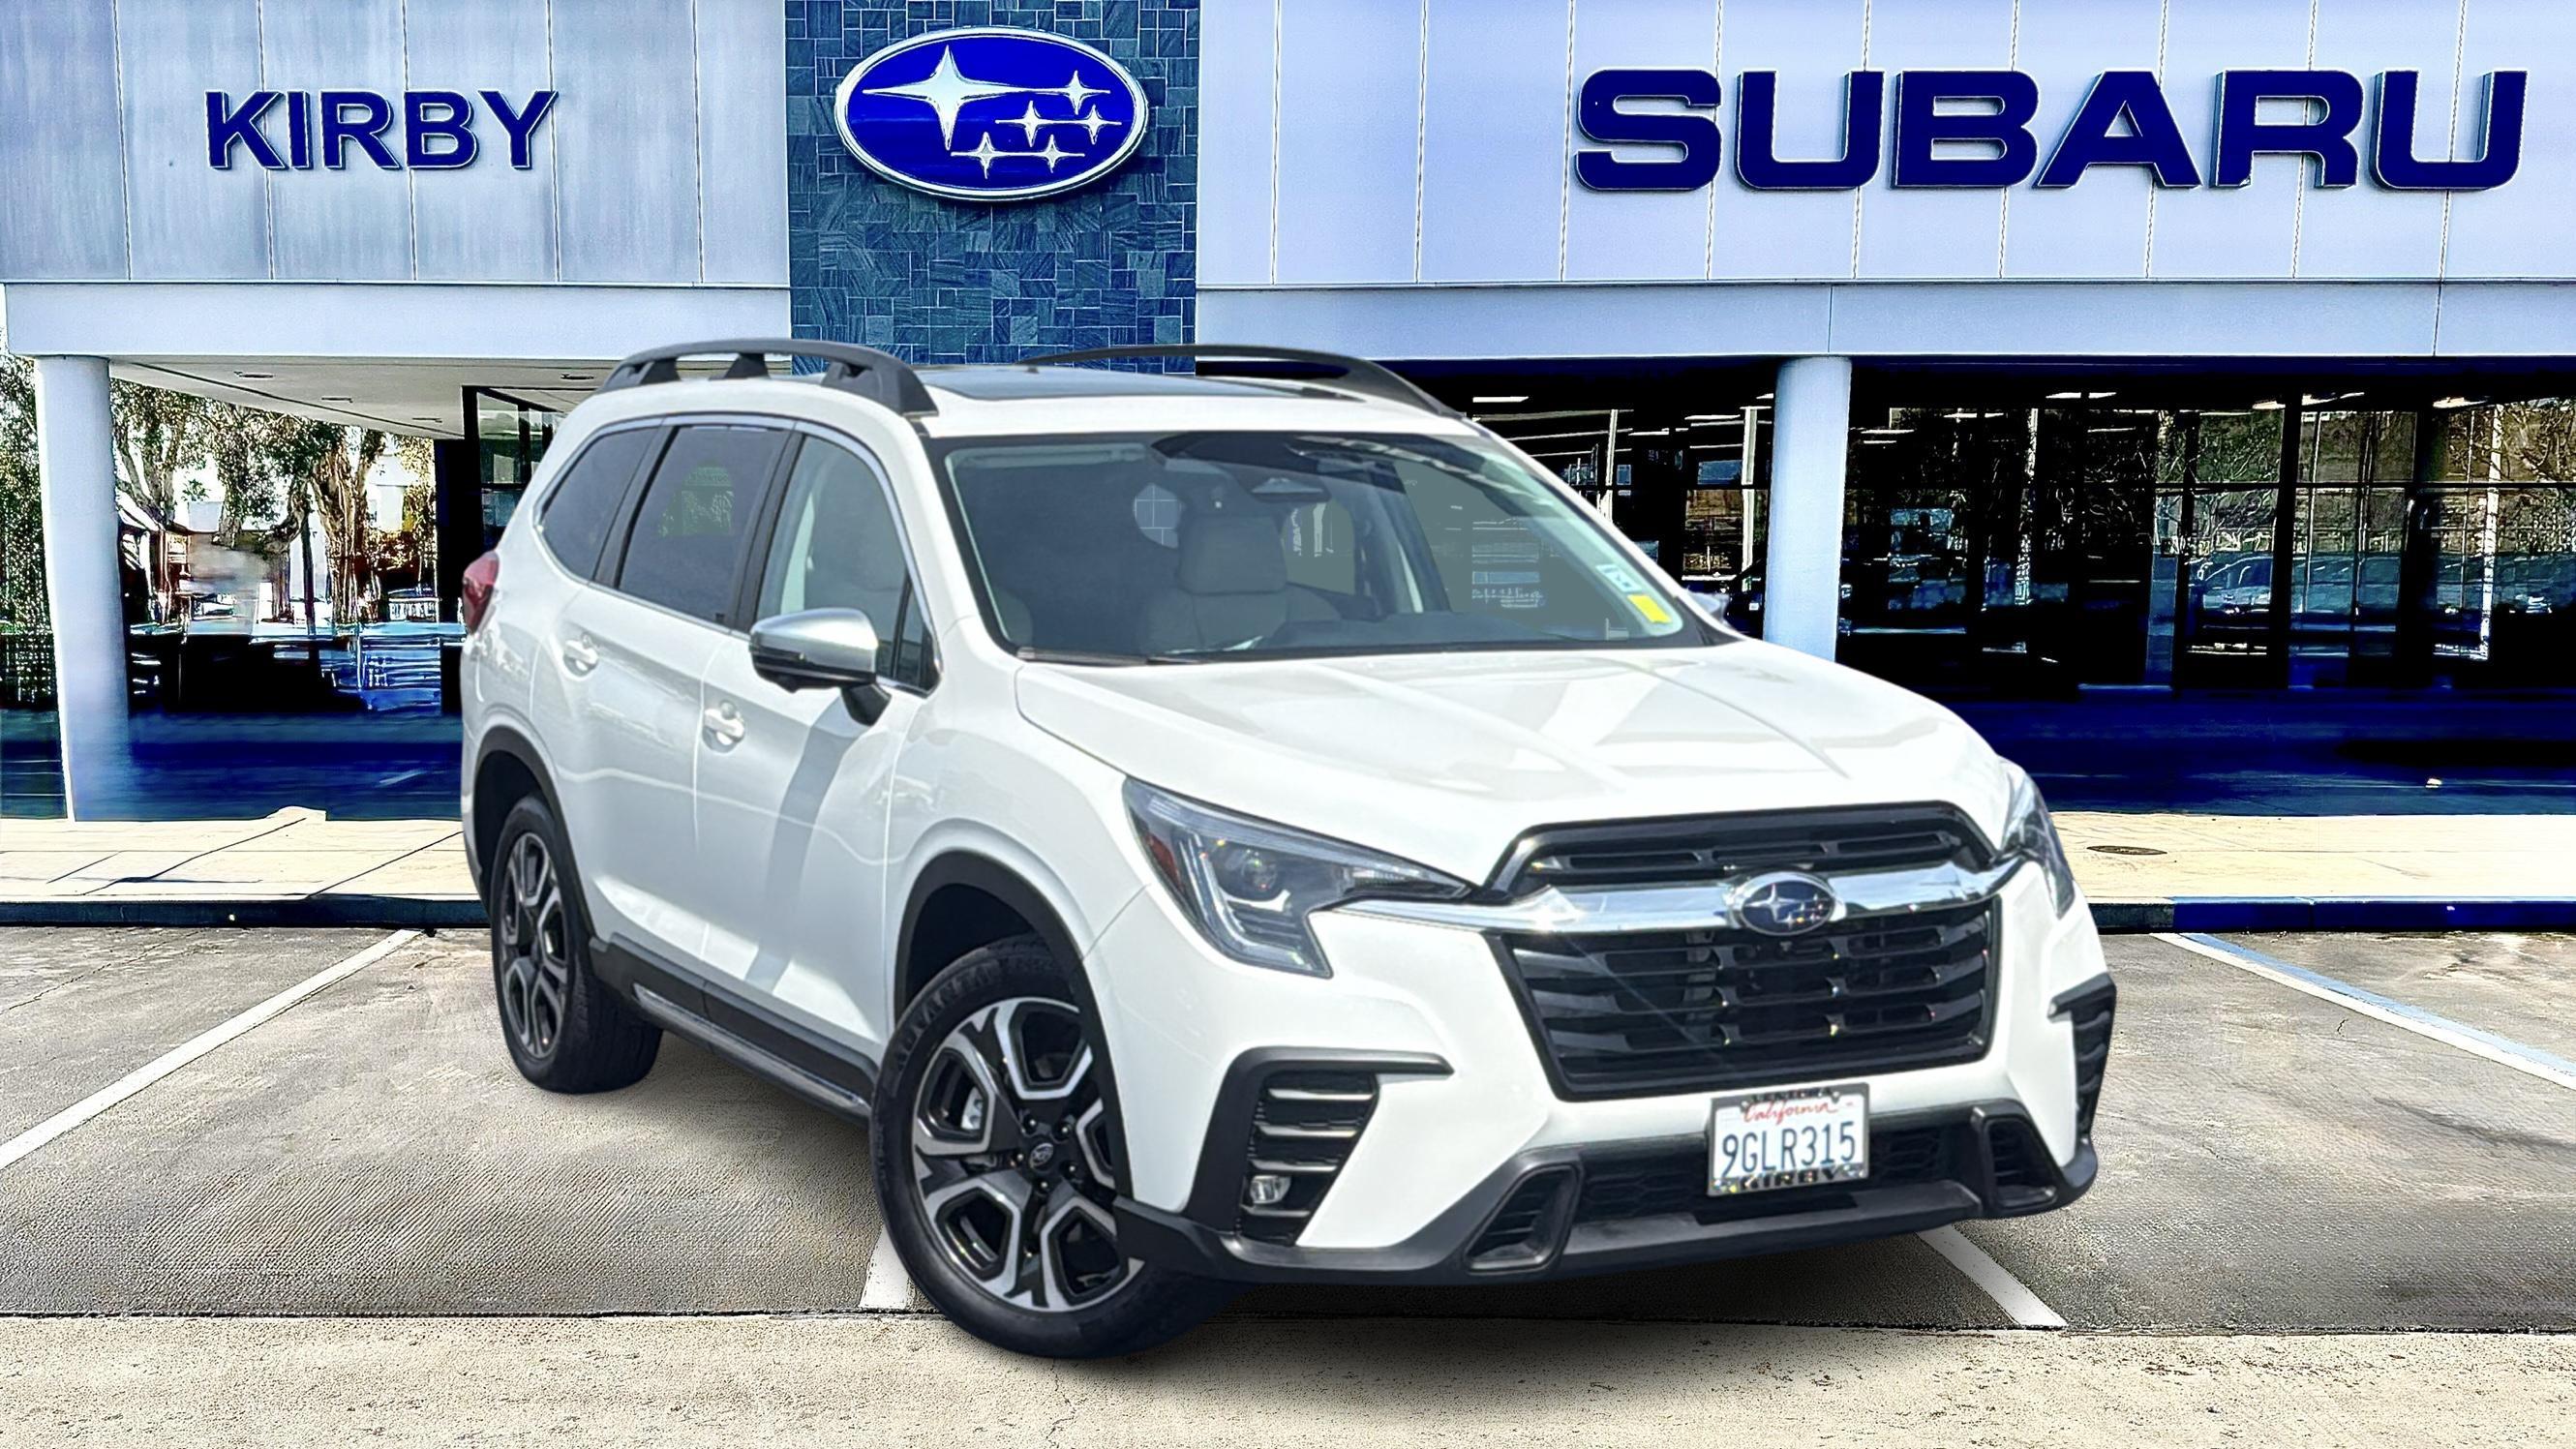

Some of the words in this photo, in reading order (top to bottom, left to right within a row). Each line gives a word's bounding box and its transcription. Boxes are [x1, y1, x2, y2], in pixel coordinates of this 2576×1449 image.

[205, 90, 558, 170] KIRBY
[1575, 68, 2528, 191] SUBARU
[1743, 1101, 1837, 1125] California
[1721, 1121, 1856, 1178] 9GLR315
[1740, 1165, 1837, 1191] KIRBY
